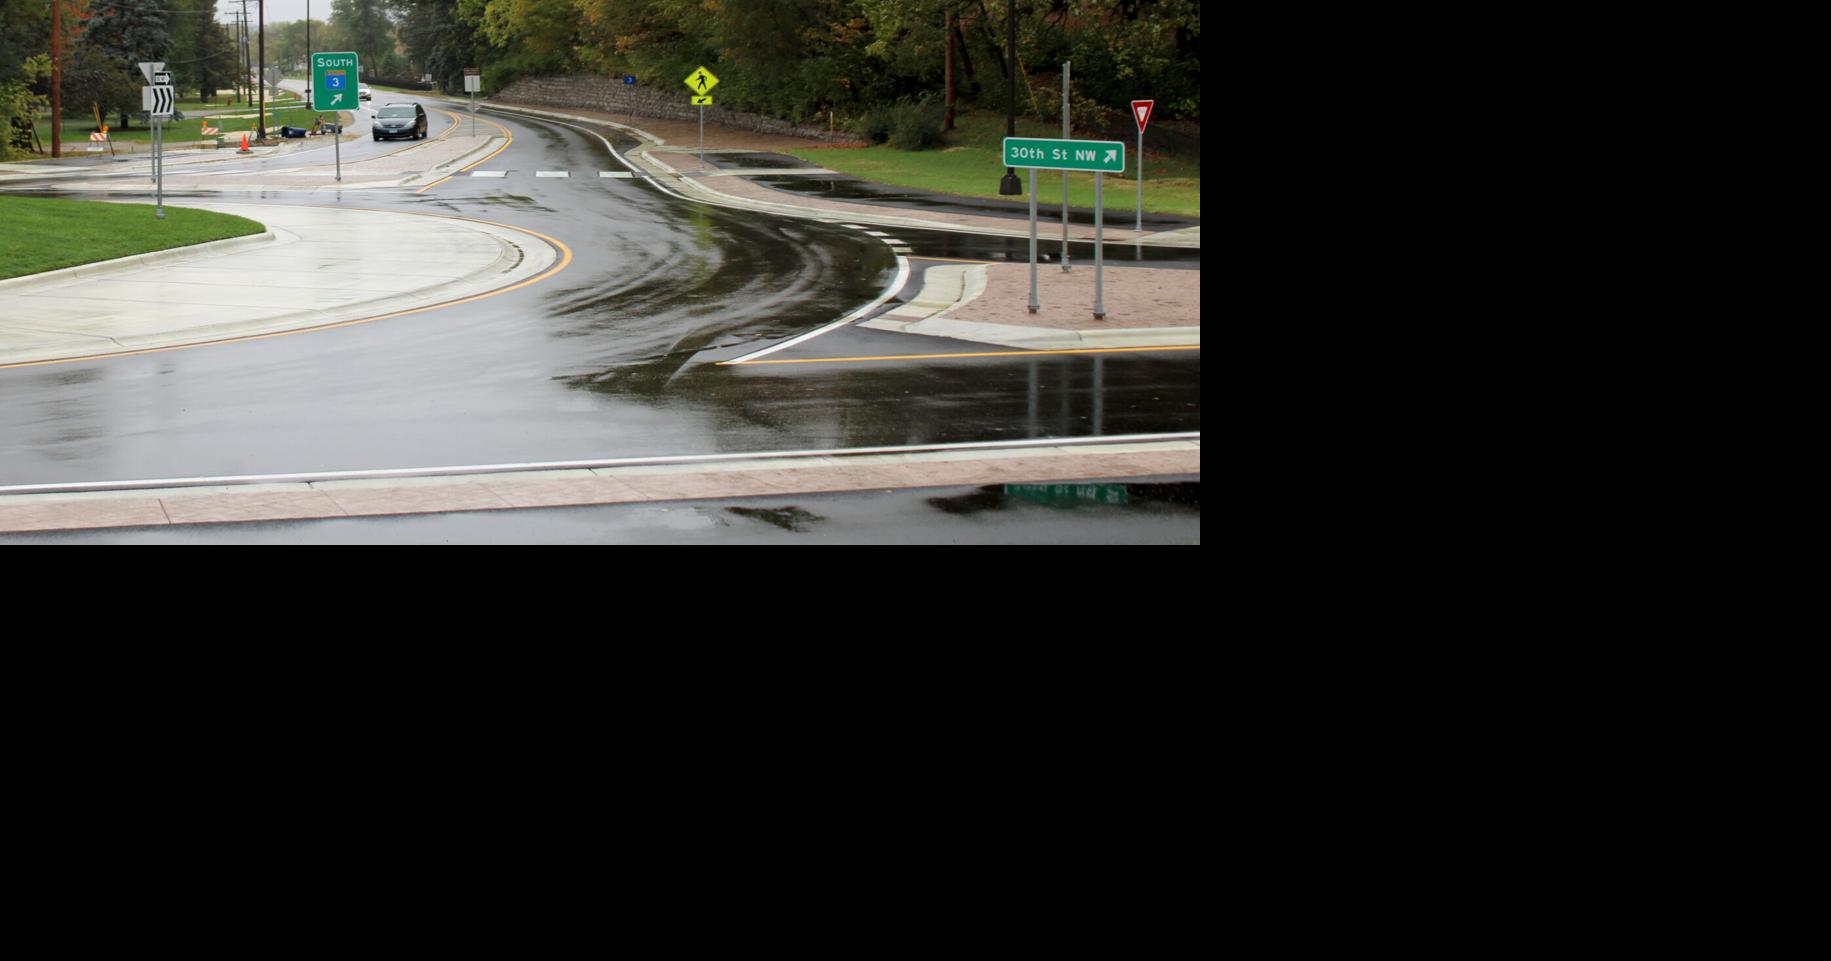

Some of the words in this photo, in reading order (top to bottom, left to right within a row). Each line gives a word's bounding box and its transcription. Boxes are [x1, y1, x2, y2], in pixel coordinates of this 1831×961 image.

[332, 77, 340, 87] 3
[1010, 146, 1044, 159] 30th
[1052, 148, 1068, 161] St
[1075, 149, 1096, 161] NW
